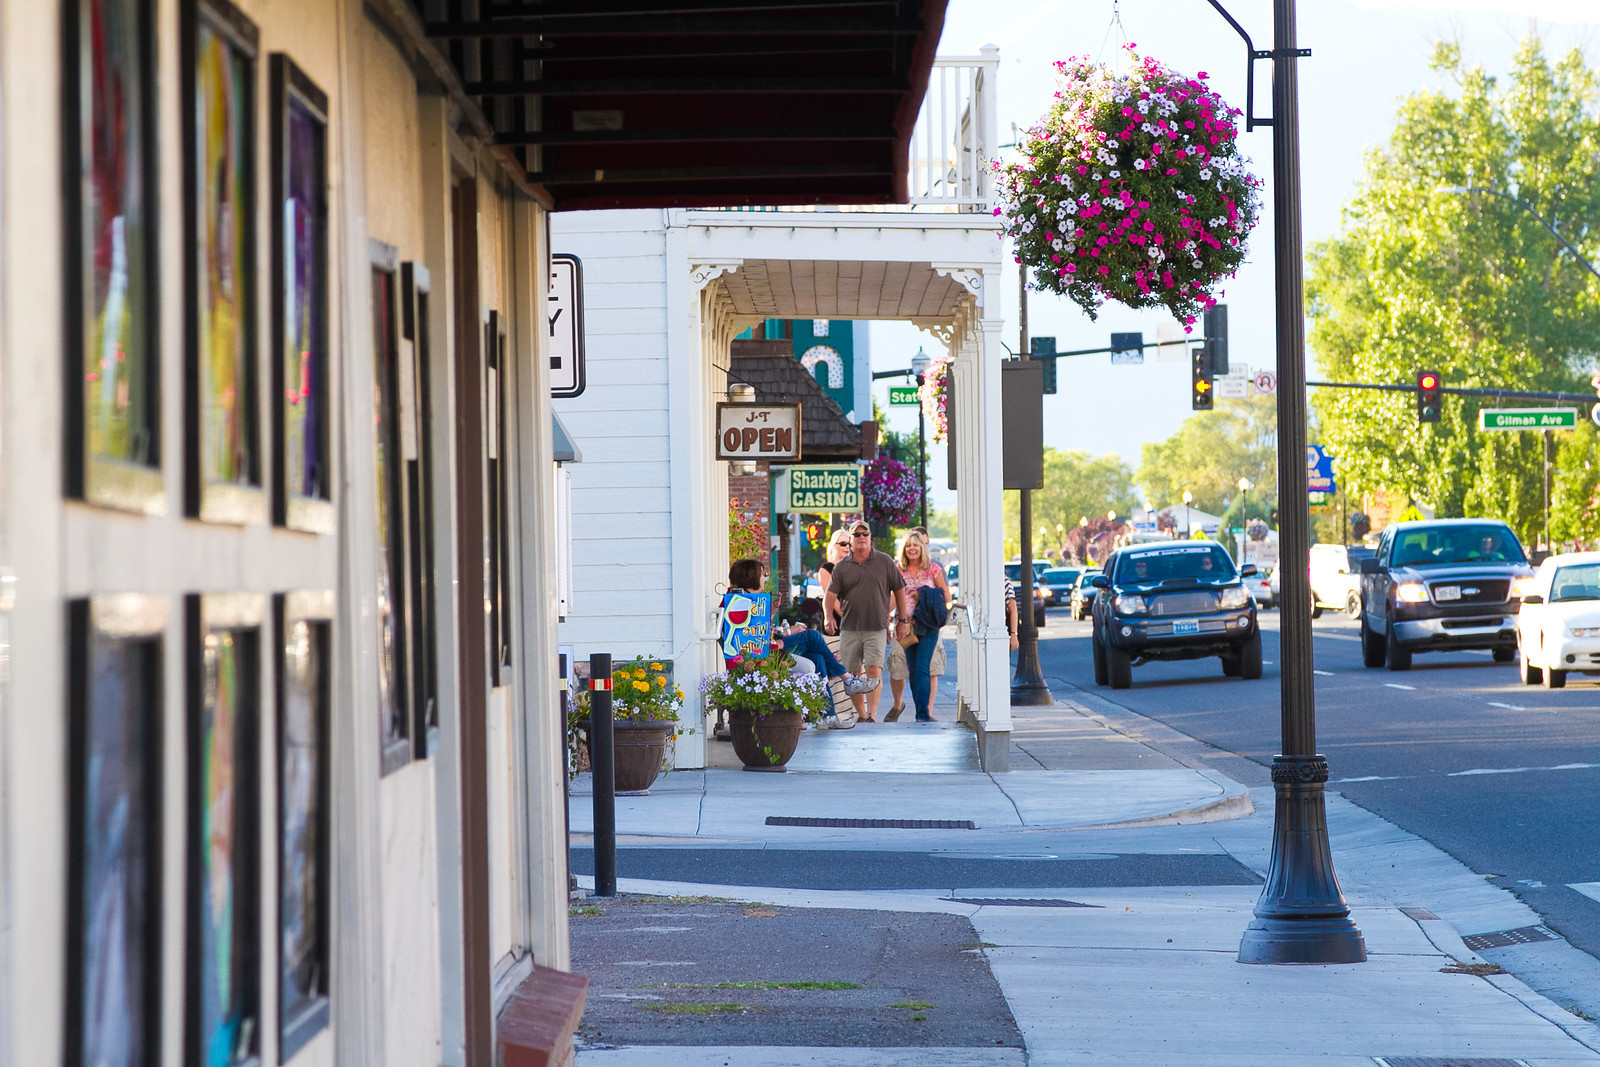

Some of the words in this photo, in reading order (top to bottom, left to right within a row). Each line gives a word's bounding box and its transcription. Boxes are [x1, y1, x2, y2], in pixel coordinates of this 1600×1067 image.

[891, 391, 920, 403] Stat
[1496, 415, 1536, 426] Gilman
[1541, 414, 1563, 425] Ave
[724, 427, 792, 452] OPEN
[792, 470, 857, 492] Sharkey's
[792, 491, 857, 507] CASINO
